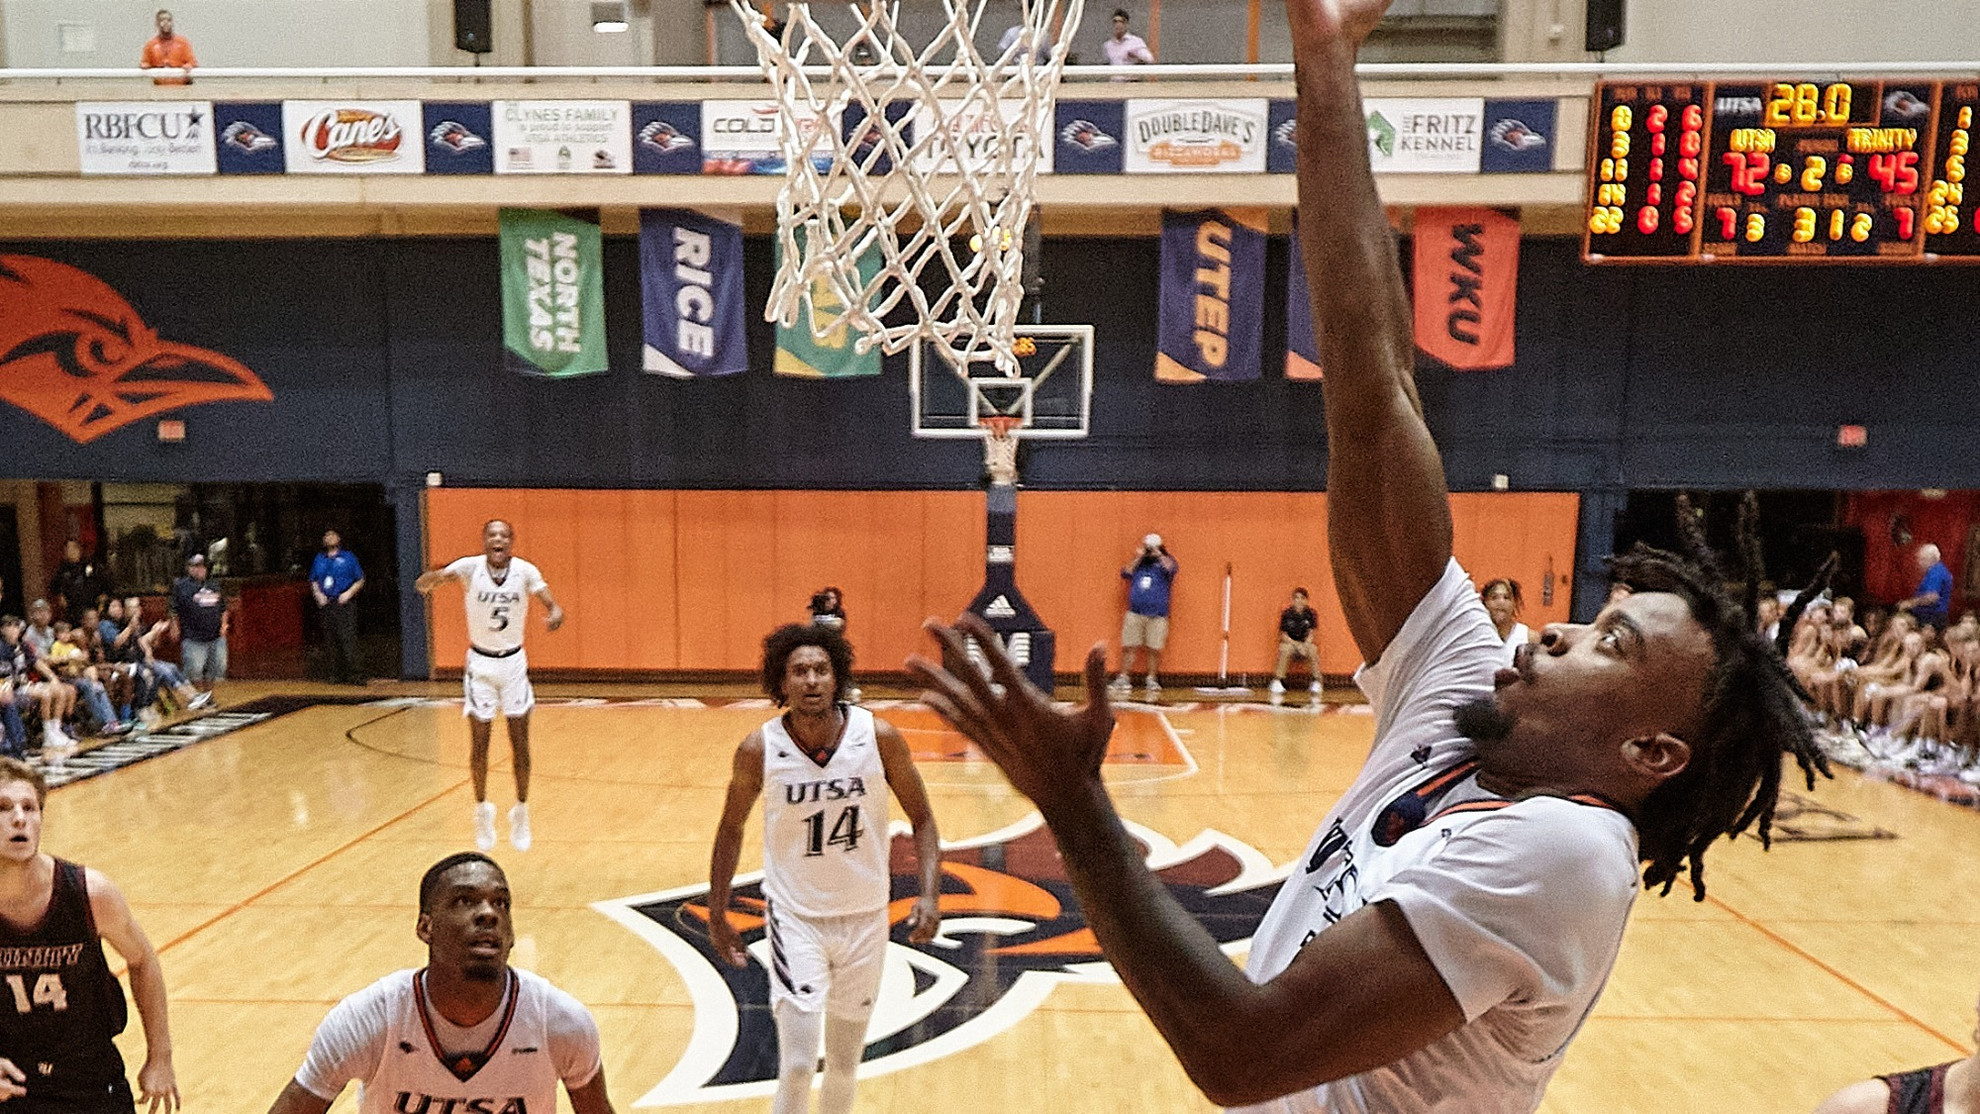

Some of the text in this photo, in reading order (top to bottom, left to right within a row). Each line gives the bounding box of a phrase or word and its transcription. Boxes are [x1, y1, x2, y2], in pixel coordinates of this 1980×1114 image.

[506, 109, 617, 121] CLYNES FAMILY
[1715, 97, 1763, 113] UTSA
[1765, 83, 1852, 127] 28.0
[84, 113, 180, 139] RBFCU
[713, 118, 775, 133] COLD
[1412, 114, 1477, 134] FRITZ
[1401, 137, 1475, 151] KENNEL
[1730, 128, 1776, 153] UTSA
[1846, 128, 1918, 153] TRINITY
[1722, 152, 1770, 196] 72
[1801, 156, 1826, 192] 2
[1868, 151, 1919, 195] 45
[1716, 207, 1737, 240] 7
[1893, 207, 1914, 240] 7
[525, 237, 554, 351] TEXAS
[553, 231, 581, 352] NORTH
[673, 226, 715, 360] RICE
[1194, 219, 1232, 368] UTEP
[1448, 223, 1485, 346] WKU
[478, 591, 520, 603] UTSA
[488, 606, 509, 632] 5
[785, 776, 867, 805] UTSA
[801, 804, 864, 857] 14
[6, 973, 68, 1014] 14
[394, 1090, 528, 1114] UTSA
